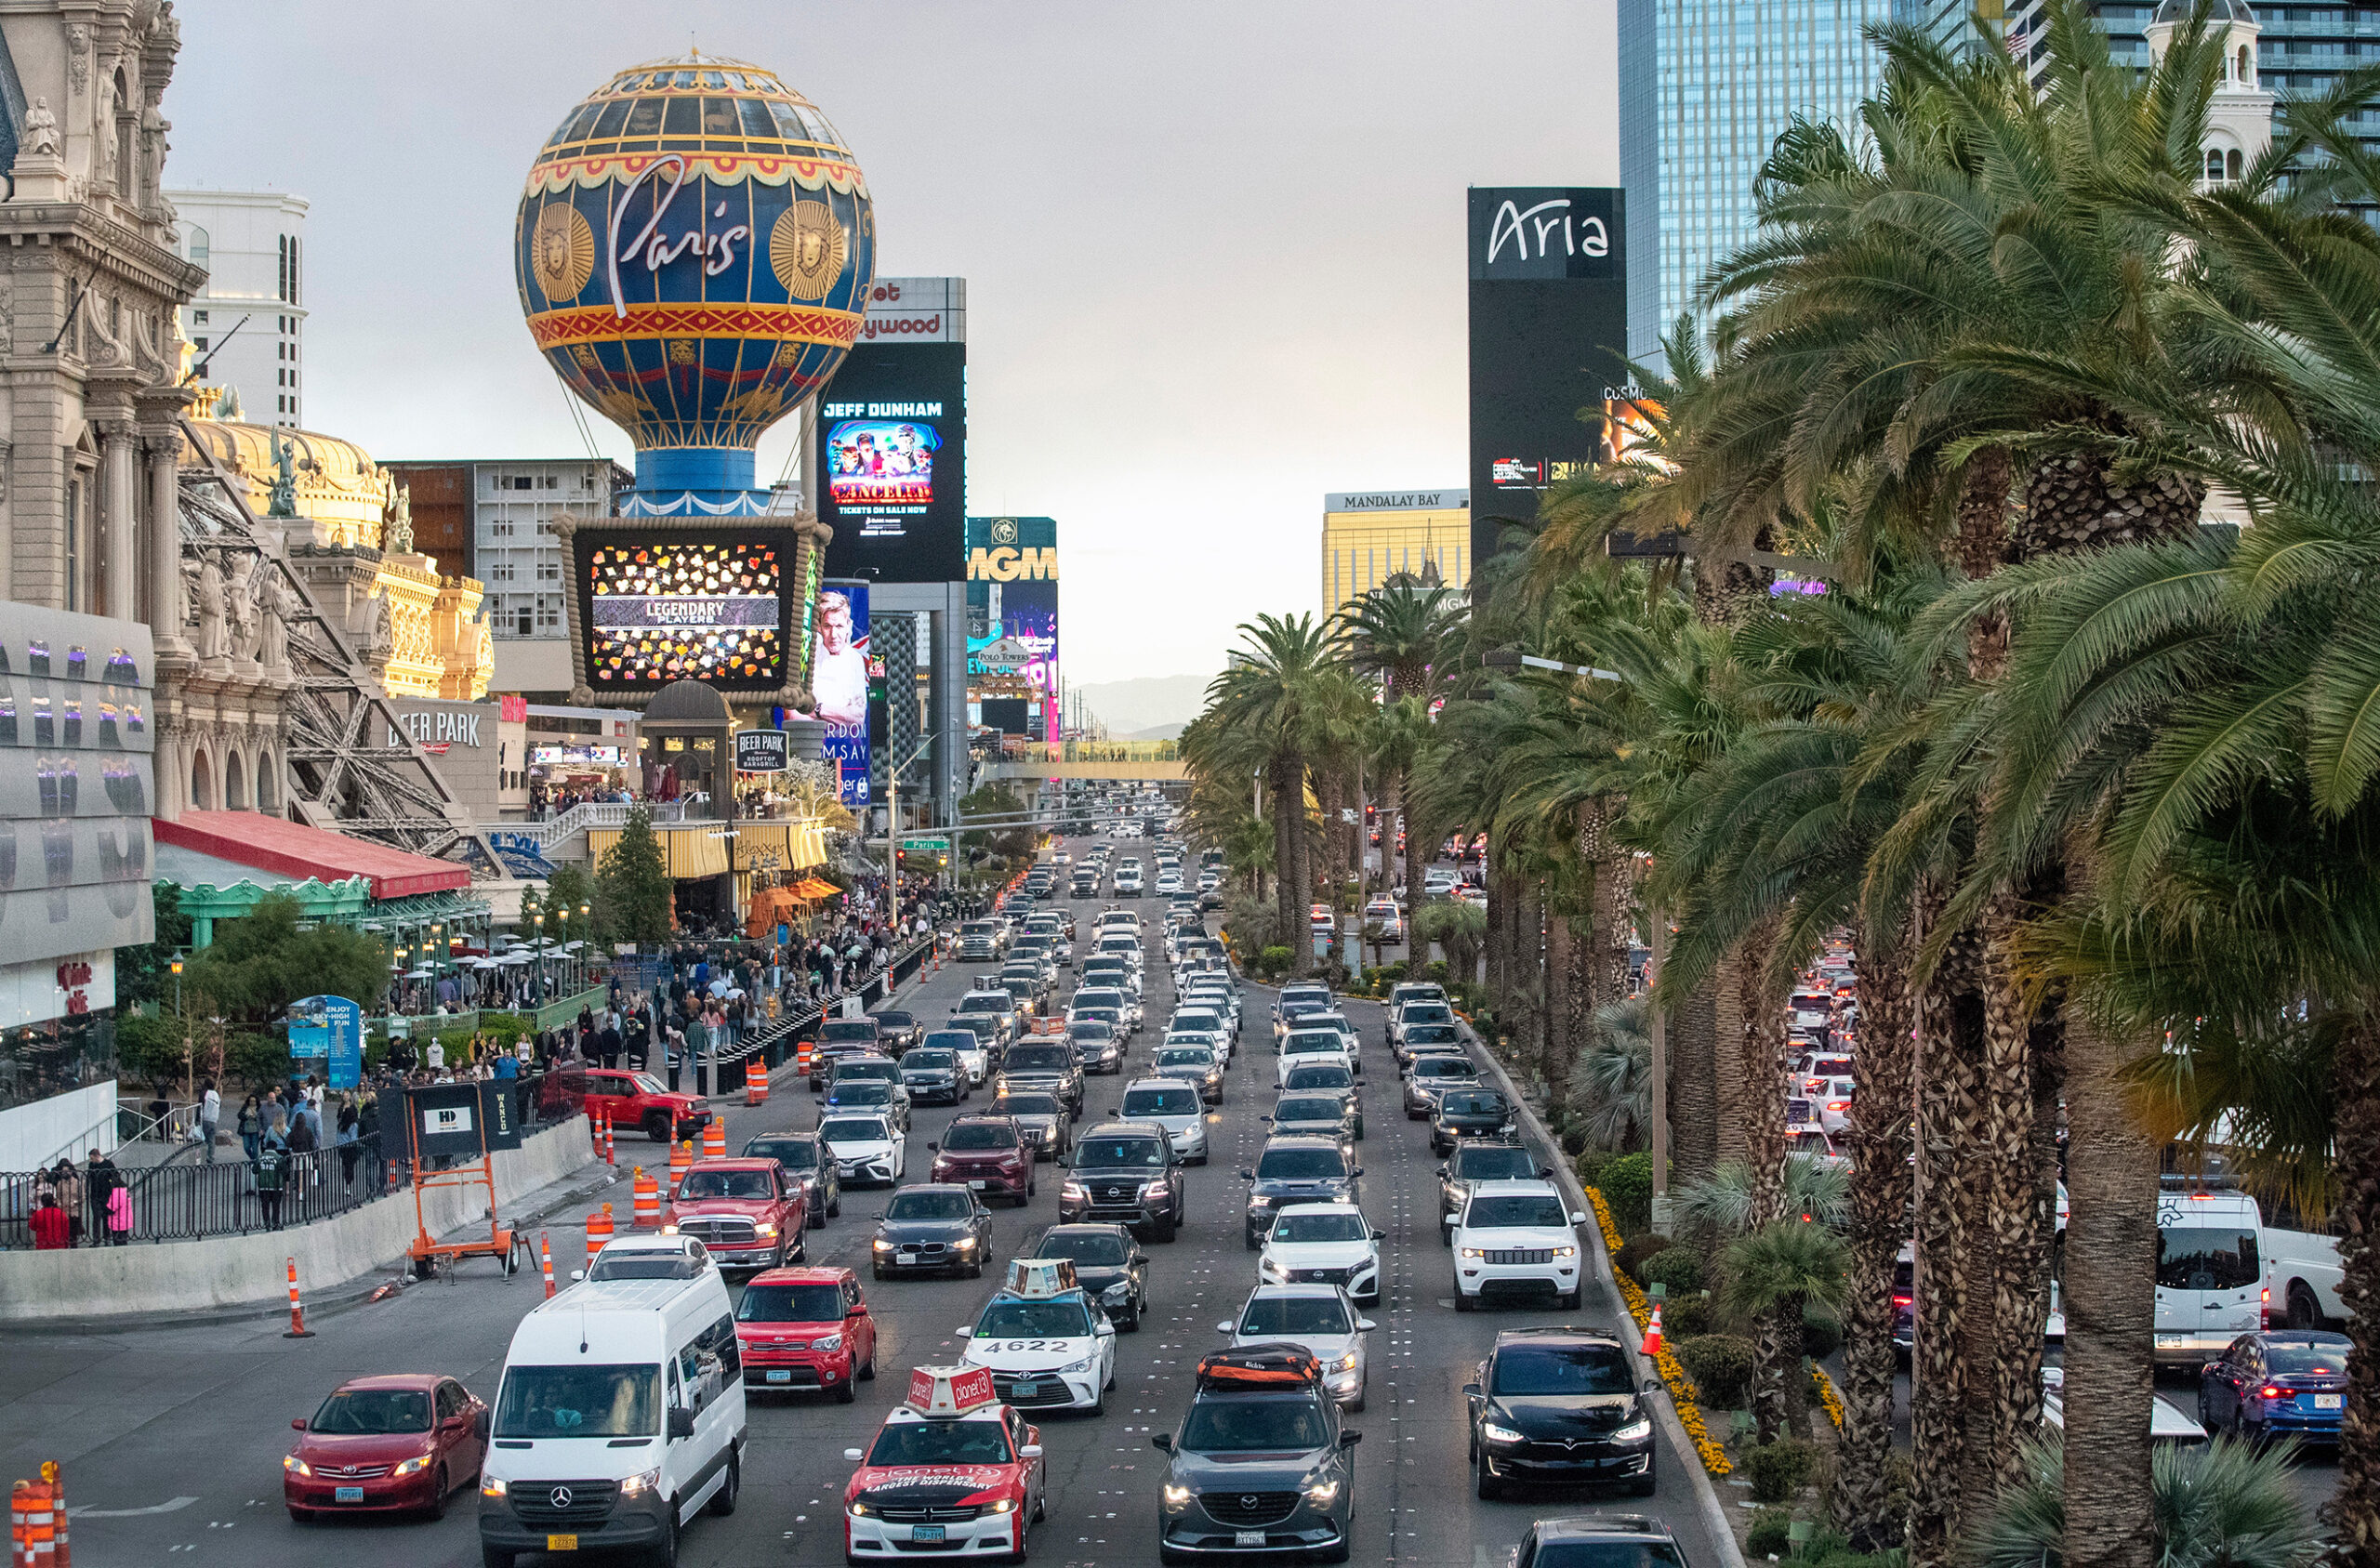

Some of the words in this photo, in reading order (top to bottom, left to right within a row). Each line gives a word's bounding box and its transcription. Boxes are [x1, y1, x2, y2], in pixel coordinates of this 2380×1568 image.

[609, 153, 749, 319] Paris
[1488, 199, 1608, 264] Aria
[860, 314, 940, 339] ywood
[824, 402, 865, 417] JEFF
[868, 402, 943, 417] DUNHAM
[1344, 495, 1414, 507] MANDALAY
[1418, 494, 1441, 506] BAY
[839, 507, 872, 515] TICKETS
[873, 507, 885, 515] ON
[886, 507, 906, 515] SALE
[907, 507, 928, 515] NOW
[967, 546, 1059, 582] MGM
[646, 602, 725, 616] LEGENDARY
[657, 615, 715, 624] PLAYERS
[436, 712, 481, 748] PARK
[826, 722, 866, 738] RDON
[740, 735, 760, 753] BEER
[762, 735, 784, 753] PARK
[823, 744, 866, 759] MSAY
[439, 1110, 456, 1123] HD
[496, 1093, 508, 1131] WANCO
[984, 1340, 1068, 1353] 4622
[956, 1378, 980, 1405] planet
[866, 1467, 960, 1482] planet
[866, 1481, 917, 1493] LARGEST
